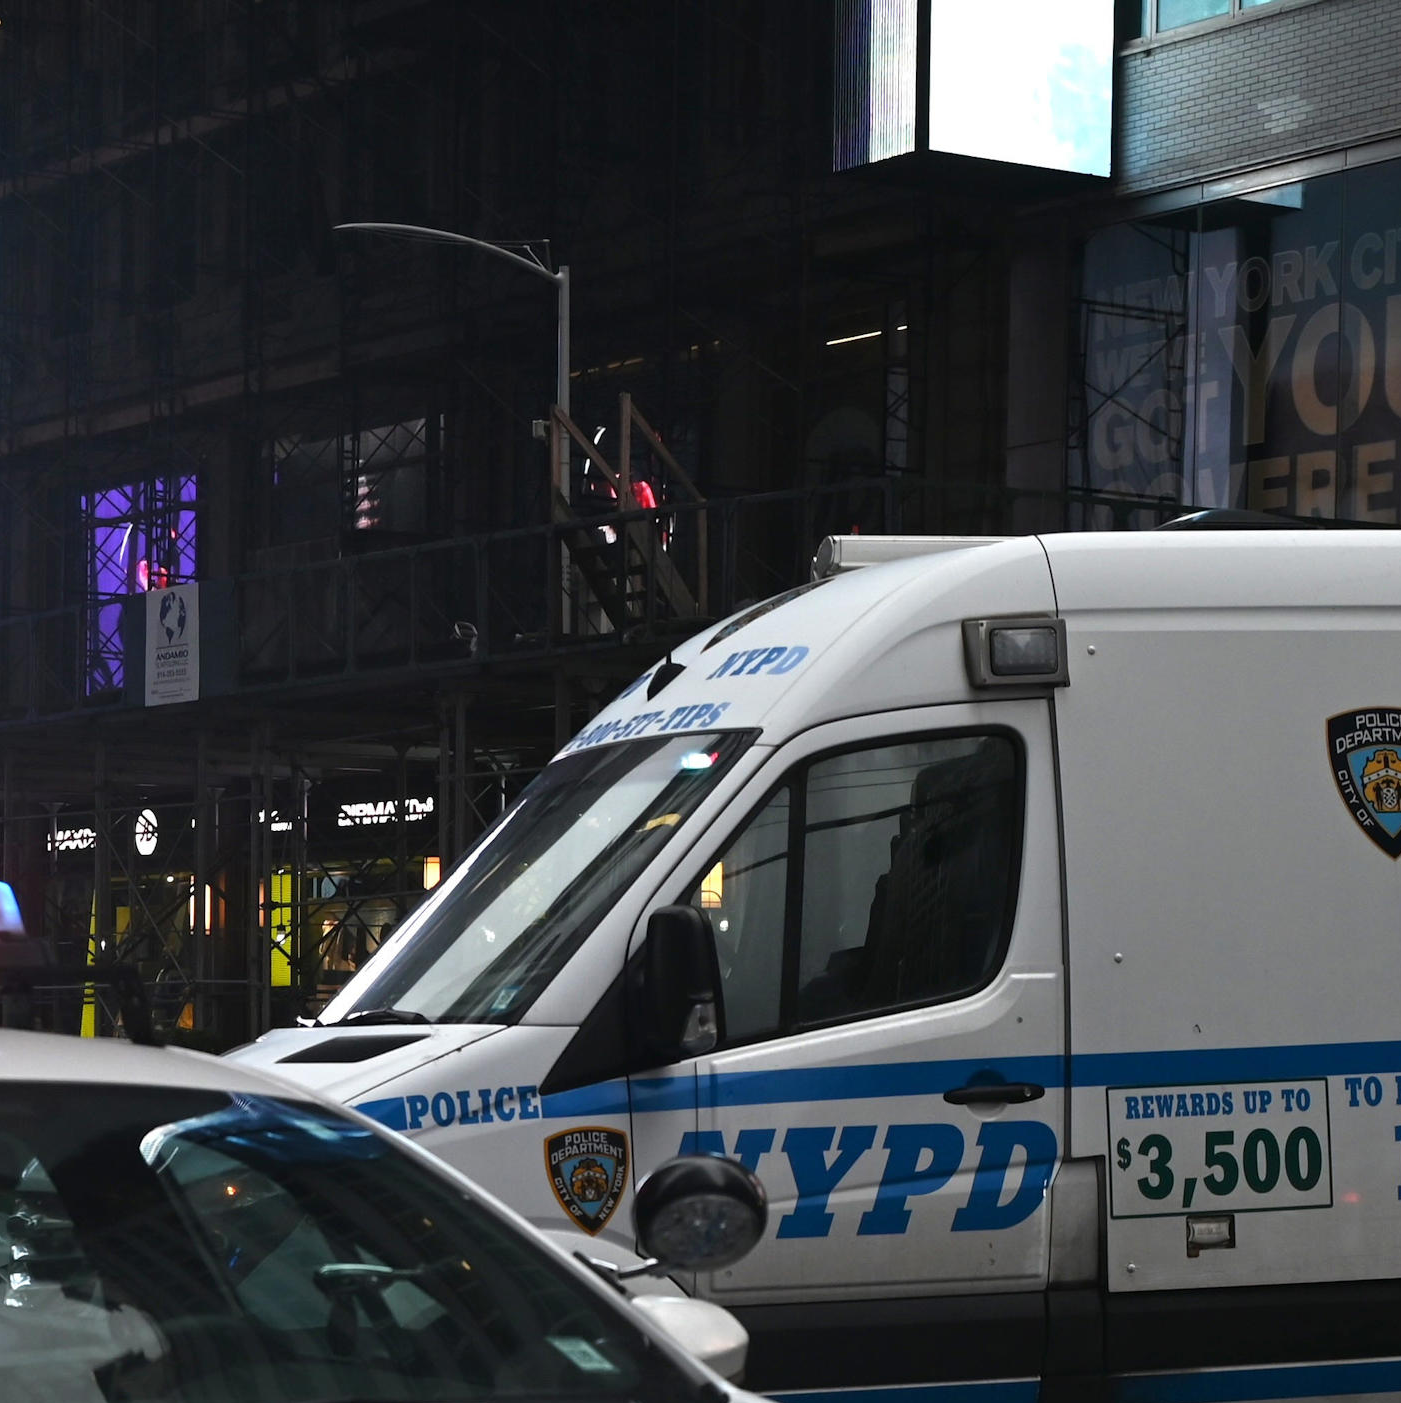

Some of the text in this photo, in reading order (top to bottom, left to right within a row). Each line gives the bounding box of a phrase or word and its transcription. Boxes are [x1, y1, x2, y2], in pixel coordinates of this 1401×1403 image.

[1205, 240, 1340, 318] YORK
[1095, 380, 1220, 472] GOT
[706, 645, 810, 680] NYPD
[1337, 769, 1375, 828] CITY OF
[407, 1085, 539, 1129] POLICE
[1125, 1088, 1311, 1120] REWARDS UP TO
[1345, 1075, 1383, 1107] TO
[550, 1142, 624, 1165] DEPARTMENT
[564, 1132, 608, 1146] POLICE
[1117, 1126, 1322, 1208] $3,500
[554, 1177, 584, 1217] CITY OF
[599, 1165, 625, 1221] NEW YORK
